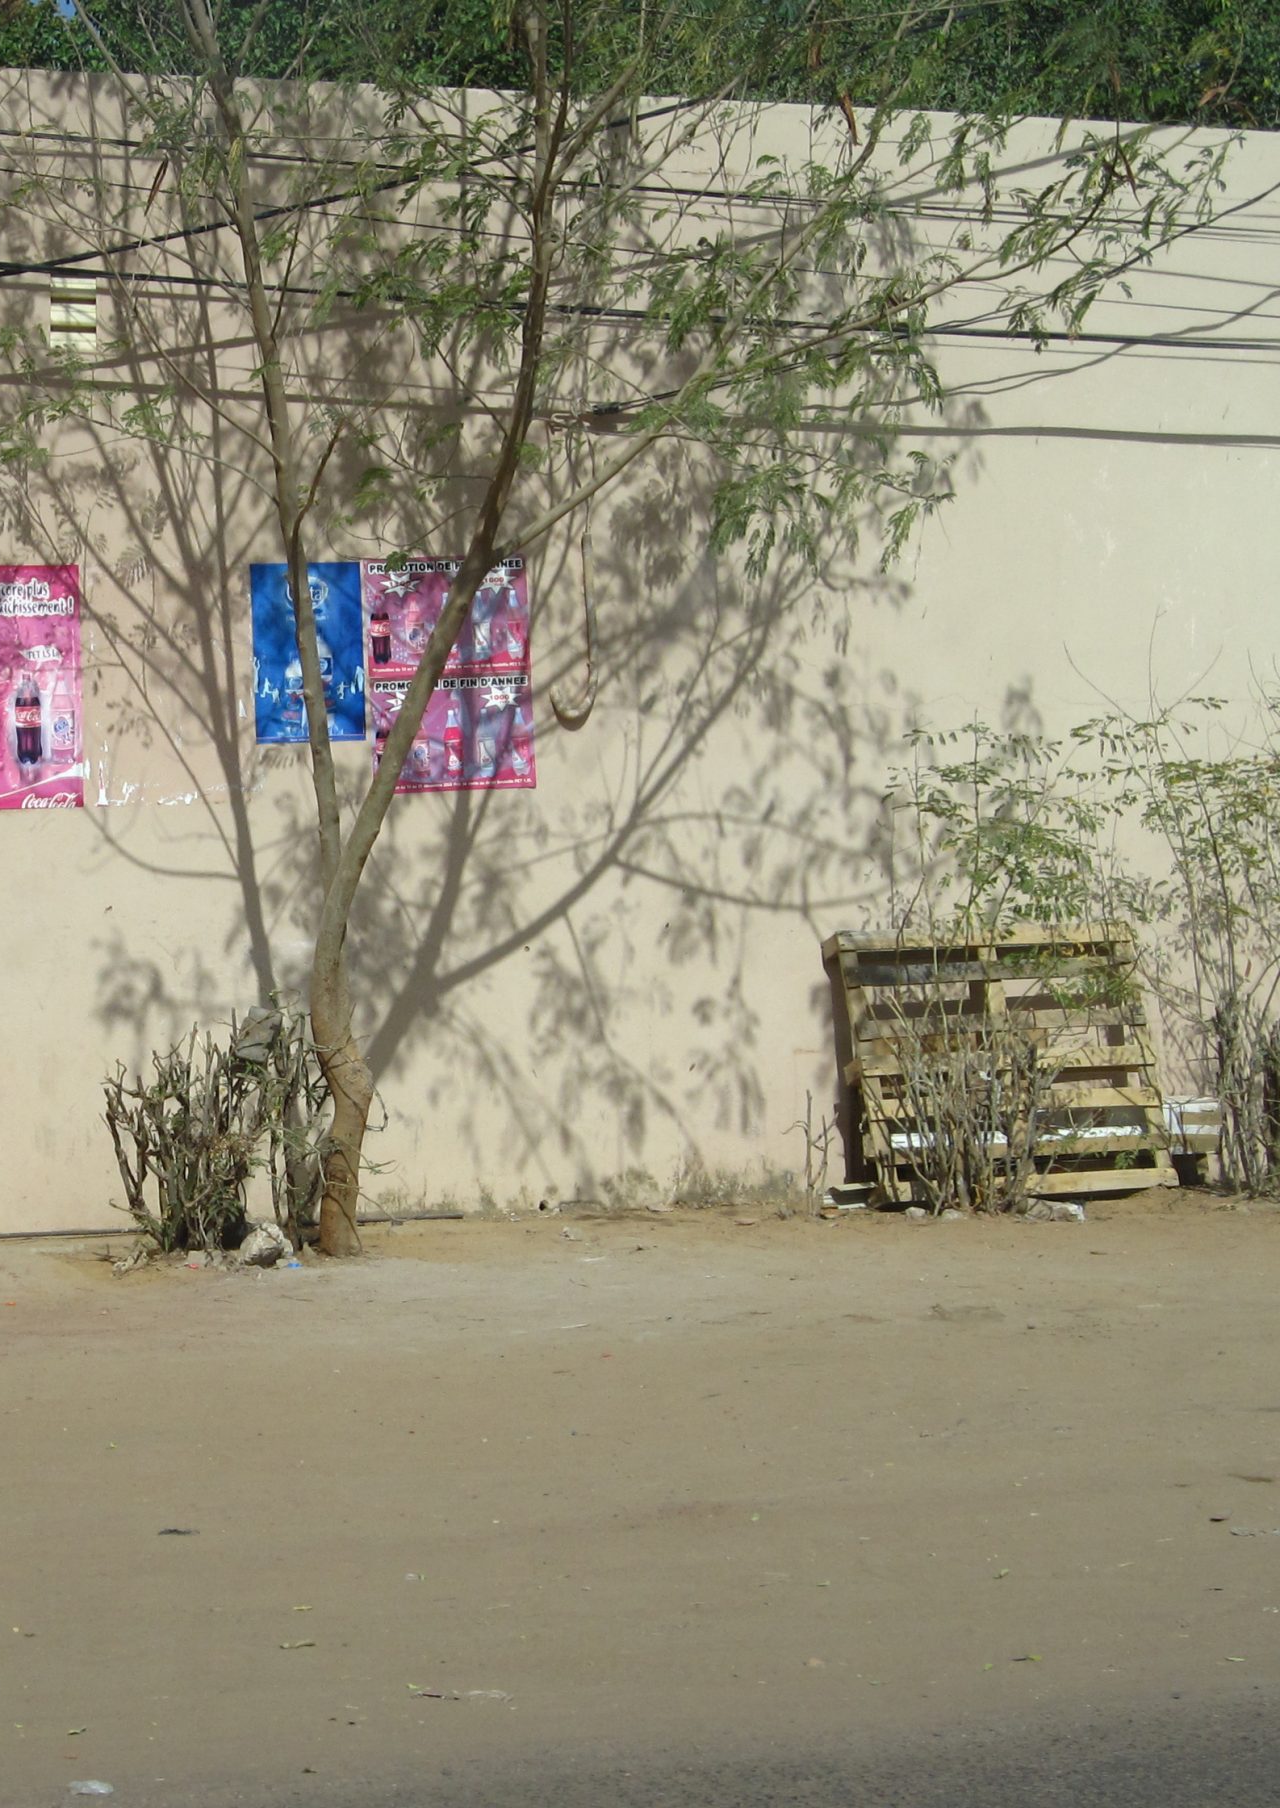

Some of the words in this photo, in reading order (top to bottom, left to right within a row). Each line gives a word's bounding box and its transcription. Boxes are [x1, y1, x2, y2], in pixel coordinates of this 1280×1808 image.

[369, 562, 435, 574] PROTION
[438, 561, 452, 571] DE
[26, 580, 48, 600] plus
[442, 679, 456, 689] DE
[460, 678, 478, 688] FIN
[481, 676, 527, 686] D'ANNEE
